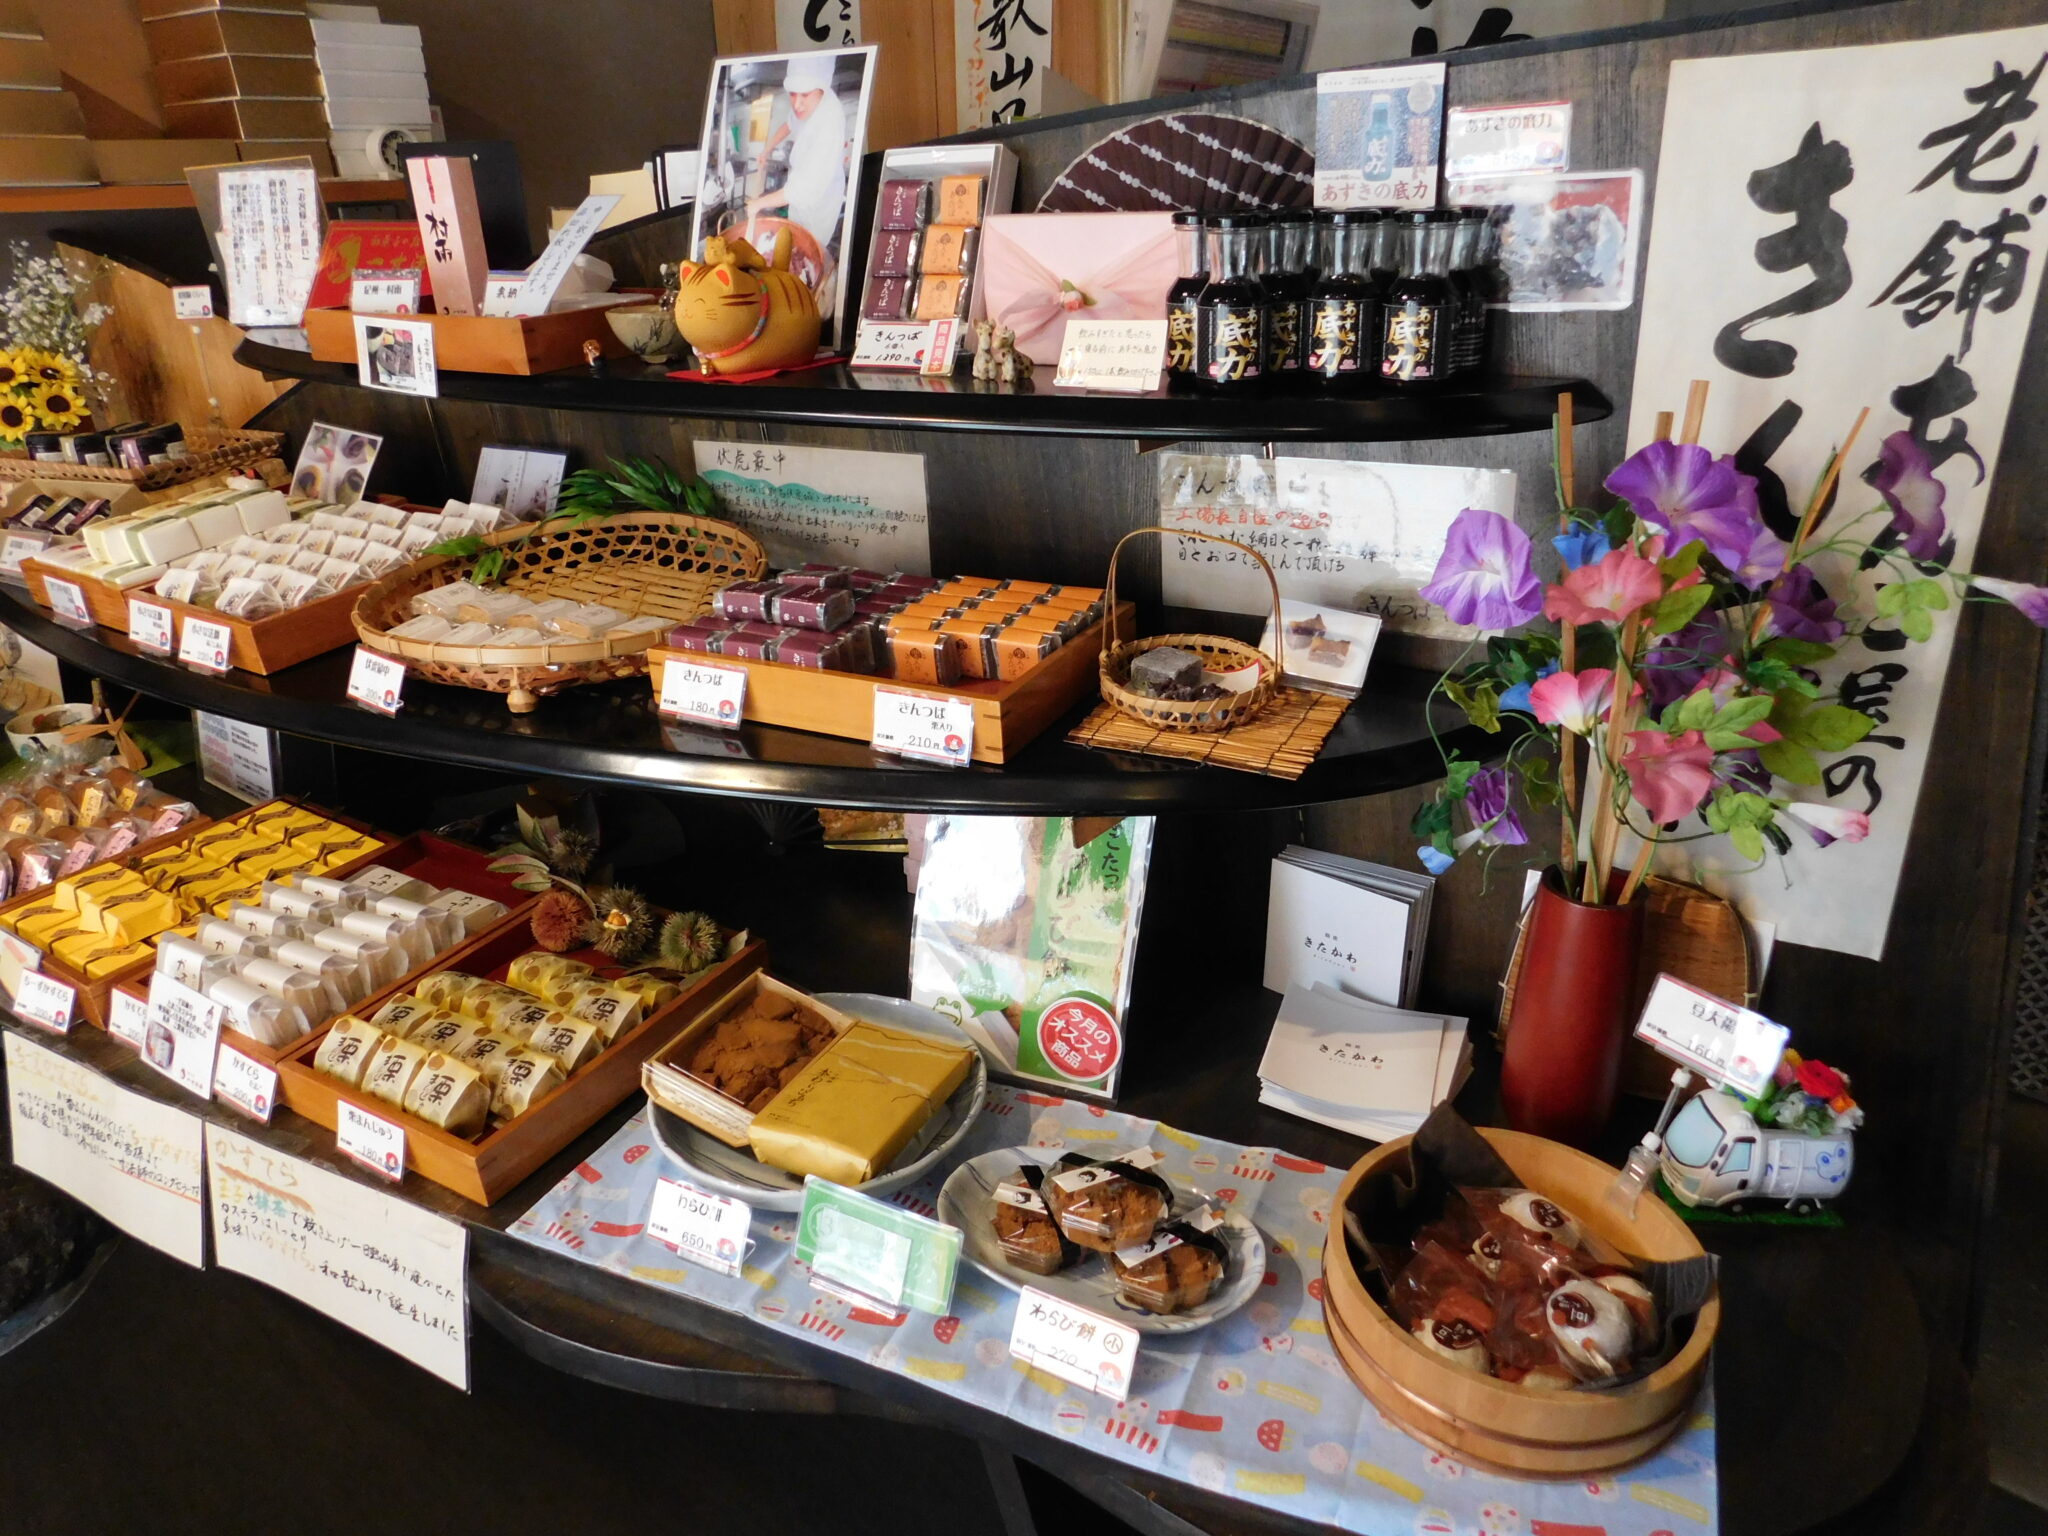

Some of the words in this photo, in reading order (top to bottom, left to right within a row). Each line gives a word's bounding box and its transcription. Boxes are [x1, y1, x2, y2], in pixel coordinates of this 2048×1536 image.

[1464, 112, 1552, 134] あずきの底力
[1321, 180, 1430, 202] あずきの底力
[424, 211, 453, 264] 村雨
[874, 330, 923, 342] きんつば
[1216, 314, 1249, 380] 底力
[1314, 306, 1347, 372] 底力
[1387, 310, 1417, 381] 底力
[716, 448, 787, 474] 伏虎最中
[683, 668, 723, 686] きんつば
[899, 702, 946, 720] きんつば
[930, 721, 953, 732] 栗入り
[1047, 1016, 1107, 1064] オススメ
[1068, 1008, 1111, 1045] 今月の
[336, 1036, 363, 1065] 栗
[1050, 1038, 1082, 1069] 商品
[382, 1054, 408, 1084] 栗
[428, 1074, 457, 1107] 栗
[348, 1110, 393, 1141] 栗まんじゅう
[1029, 1302, 1098, 1343] わらび餅
